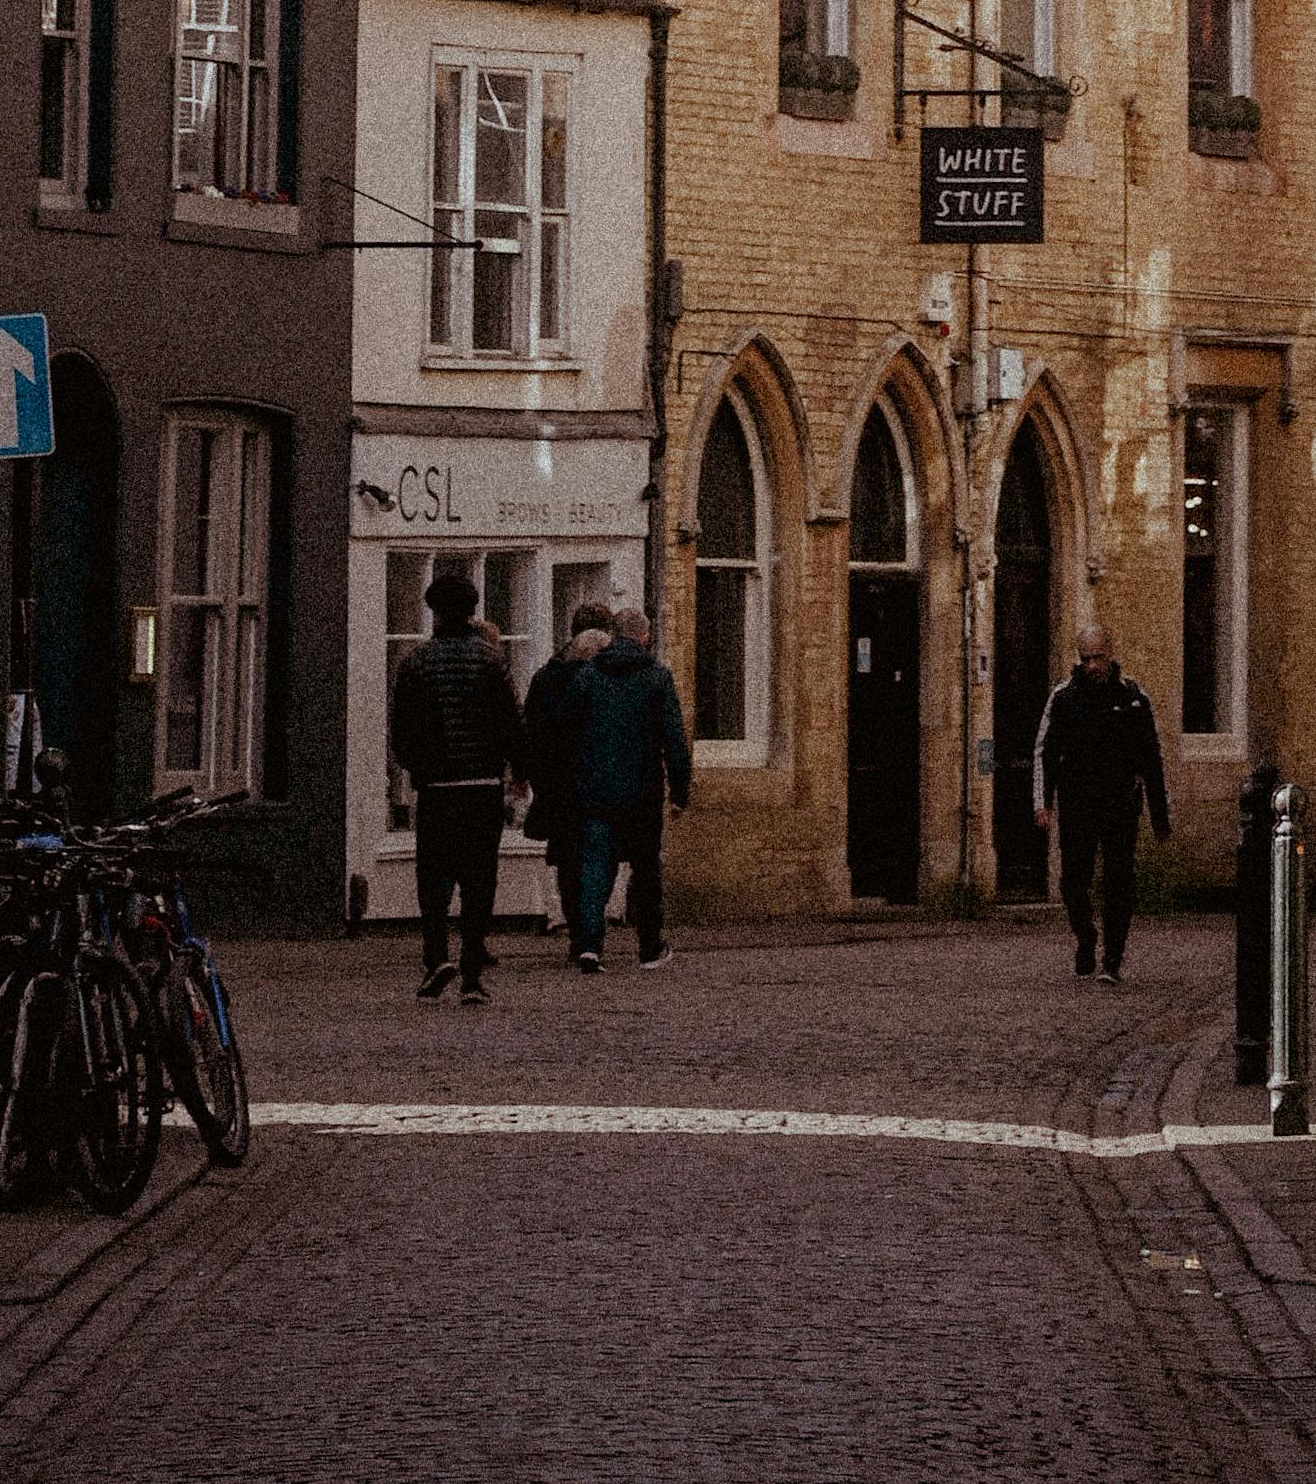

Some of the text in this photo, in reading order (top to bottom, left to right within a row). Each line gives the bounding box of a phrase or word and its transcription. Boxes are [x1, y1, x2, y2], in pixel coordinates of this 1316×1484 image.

[938, 146, 1027, 174] WHITE
[935, 189, 1025, 218] STUFF
[398, 465, 461, 523] CSL
